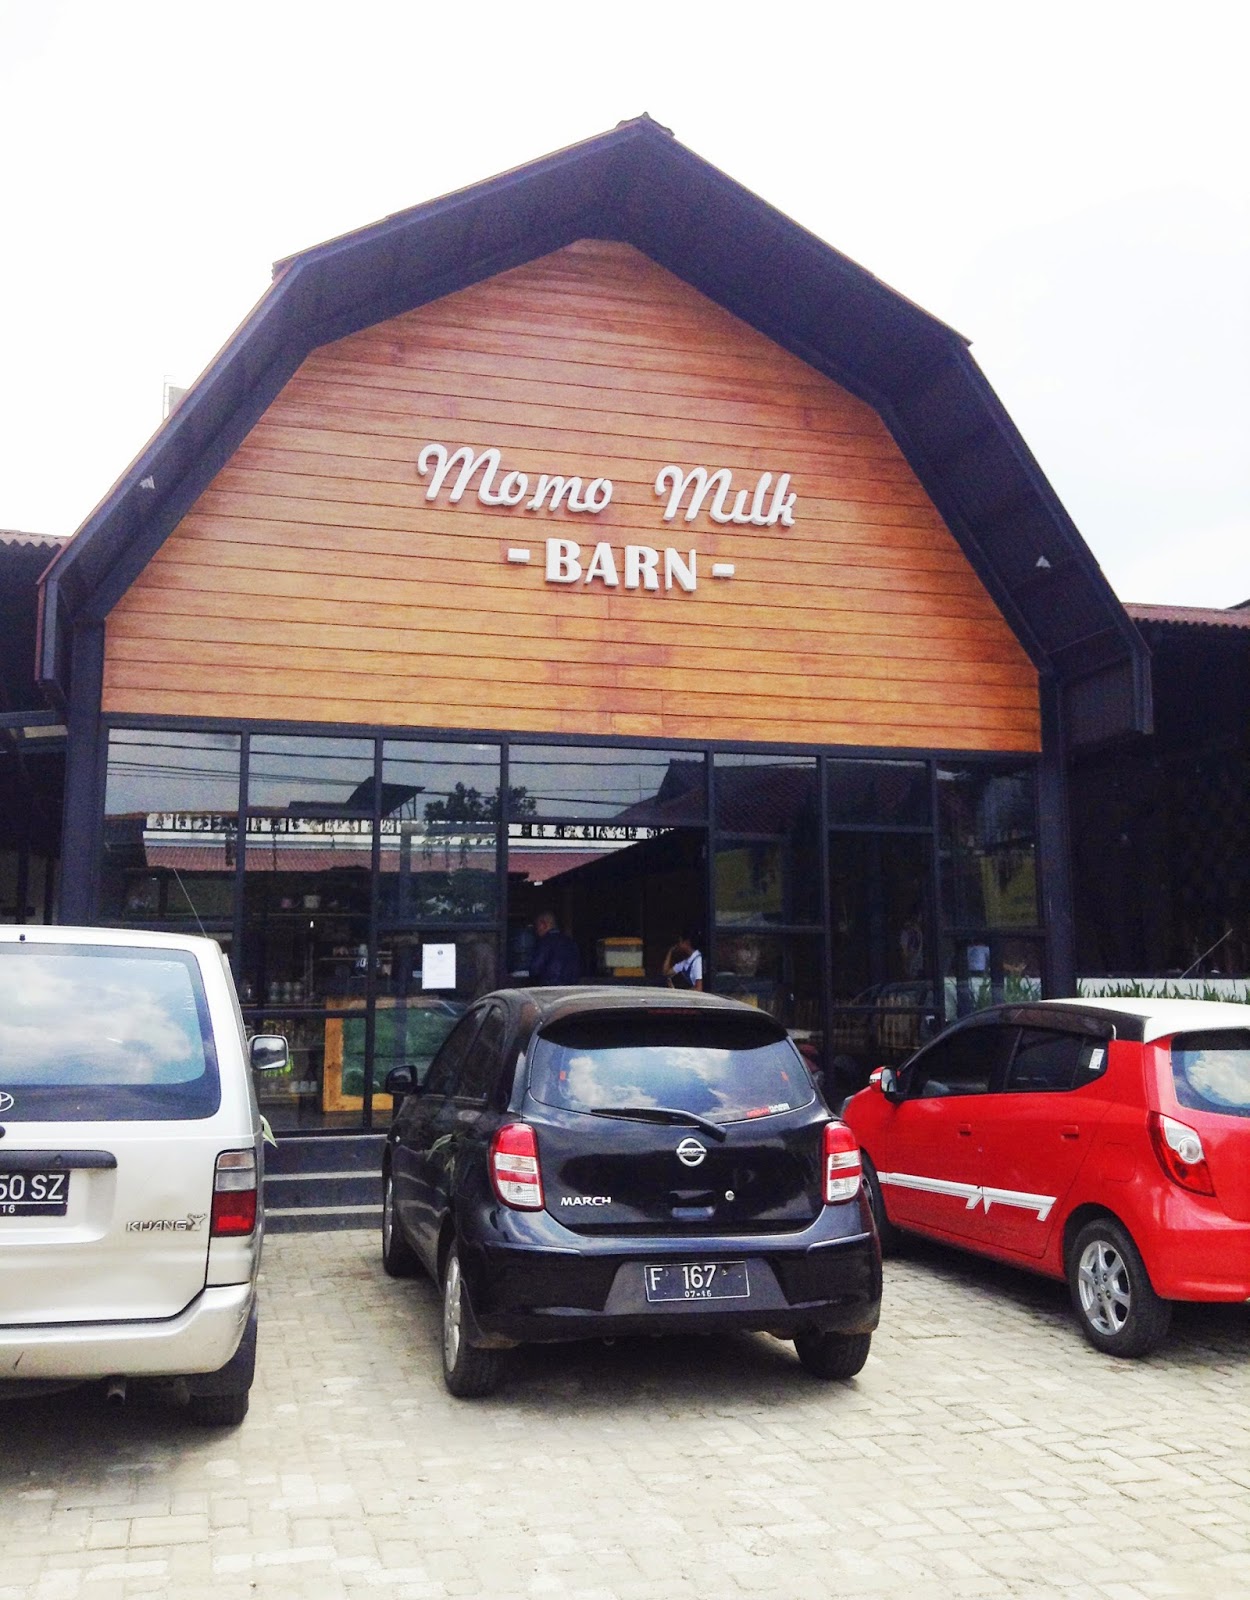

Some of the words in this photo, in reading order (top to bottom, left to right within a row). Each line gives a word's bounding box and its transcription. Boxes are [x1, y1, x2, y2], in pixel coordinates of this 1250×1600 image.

[417, 443, 613, 514] Momo
[655, 465, 797, 527] Milk
[545, 537, 697, 592] BARN
[31, 1174, 65, 1200] SZ
[560, 1196, 612, 1206] MARCH
[125, 1219, 187, 1232] KIJANG
[650, 1267, 663, 1291] F
[682, 1265, 717, 1290] 167
